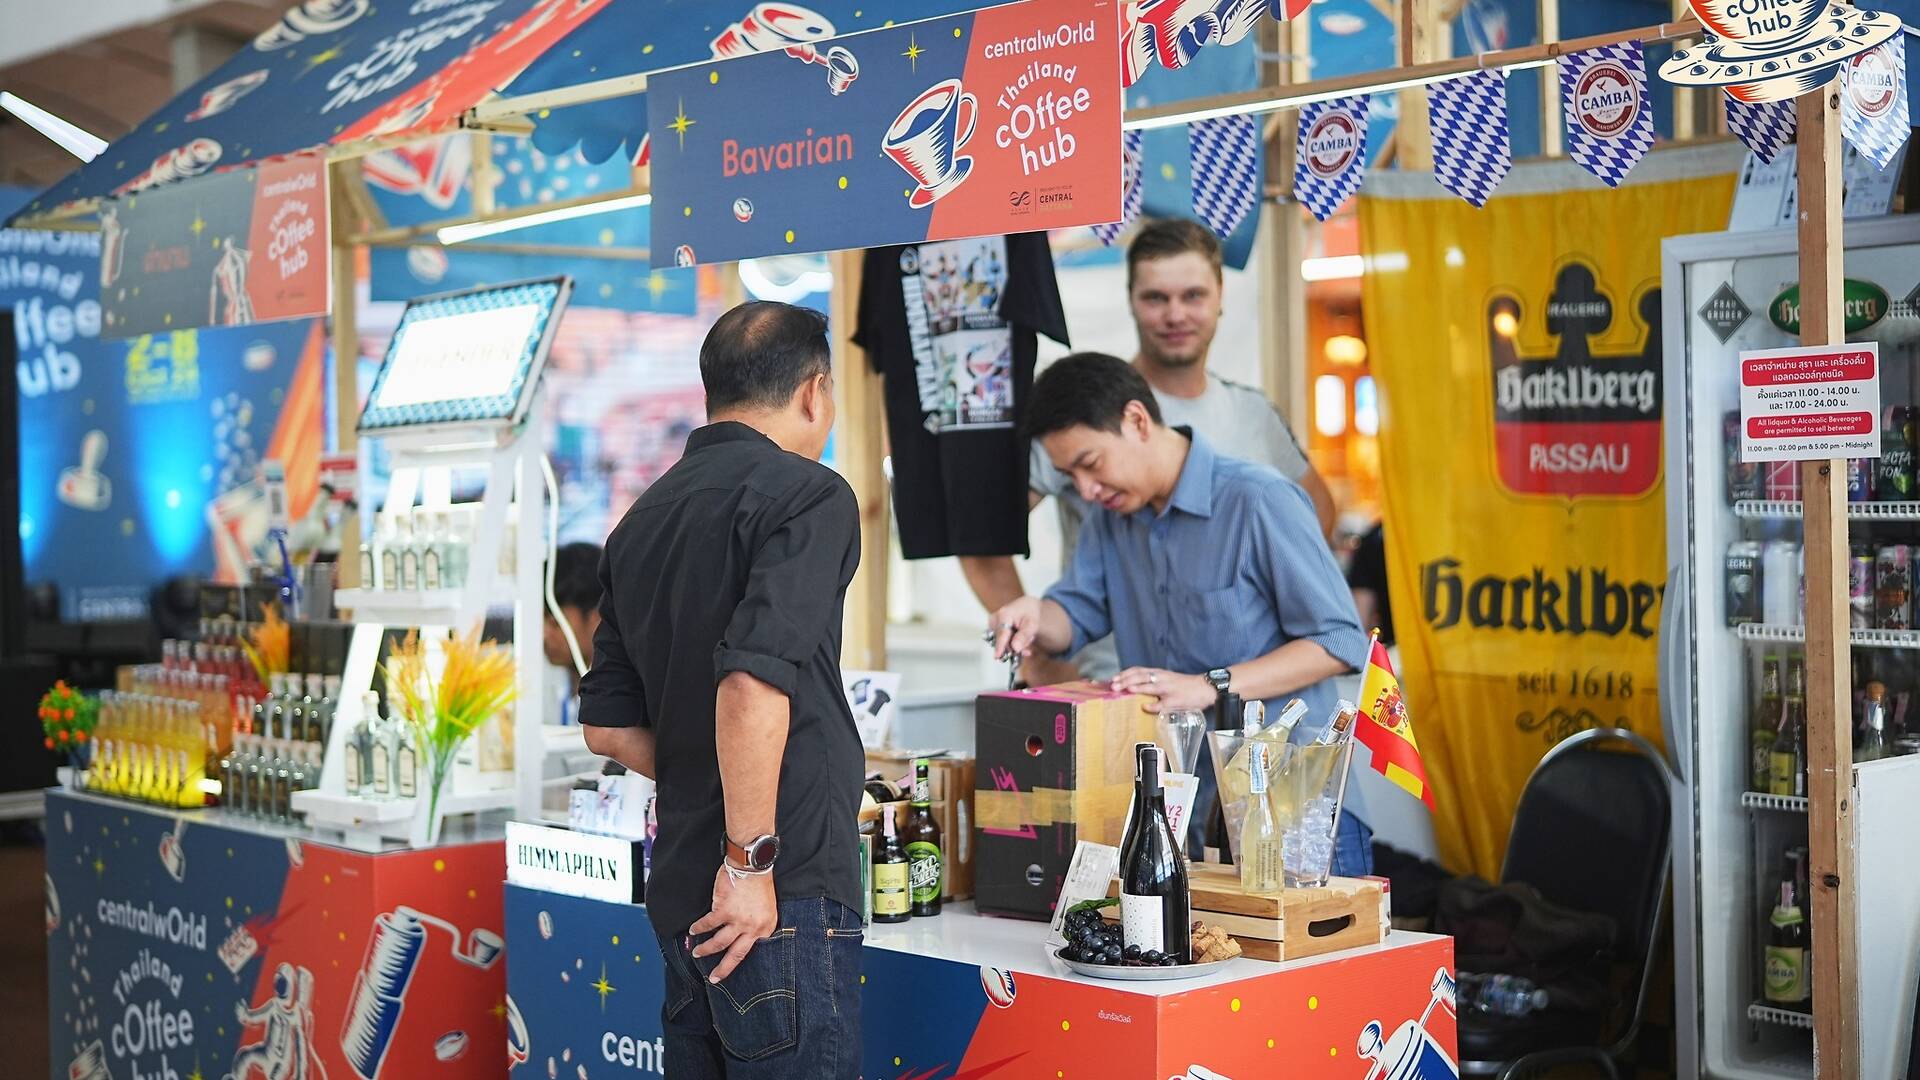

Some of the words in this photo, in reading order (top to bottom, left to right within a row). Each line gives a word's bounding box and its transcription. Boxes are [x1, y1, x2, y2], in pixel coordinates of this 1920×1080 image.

[1747, 10, 1792, 36] hub
[985, 20, 1095, 59] centralwOrld
[996, 61, 1077, 110] Thailand
[1851, 70, 1893, 87] CAMBA
[1581, 90, 1632, 111] CAMBA
[995, 87, 1091, 148] cOffee
[722, 128, 853, 177] Bavarian
[1020, 127, 1076, 176] hub
[1310, 137, 1352, 153] CAMBA
[1039, 192, 1073, 203] CENTRAL
[280, 246, 309, 280] hub
[1713, 299, 1737, 309] FRAU
[1814, 359, 1829, 368] และ
[1830, 353, 1866, 367] เครื่องดื่ม
[1769, 401, 1783, 410] และ
[1785, 400, 1806, 409] 17.00
[1814, 399, 1839, 408] 24.00
[1798, 387, 1819, 397] 11.00
[1827, 386, 1850, 395] 14.00
[1767, 418, 1790, 428] lidquor
[1797, 417, 1827, 425] Alcoholic
[1828, 415, 1862, 424] Beverages
[1776, 427, 1807, 436] permitted
[1815, 425, 1827, 433] sell
[1827, 424, 1856, 432] between
[1845, 441, 1873, 450] Midnight
[1516, 669, 1557, 695] seit
[1569, 666, 1634, 699] 1618
[1175, 805, 1183, 817] 2
[518, 844, 617, 881] HIMMAPHAN
[97, 898, 207, 950] centralwOrld
[112, 948, 184, 1005] Thailand
[111, 999, 194, 1058] cOffee
[131, 1053, 181, 1080] hb
